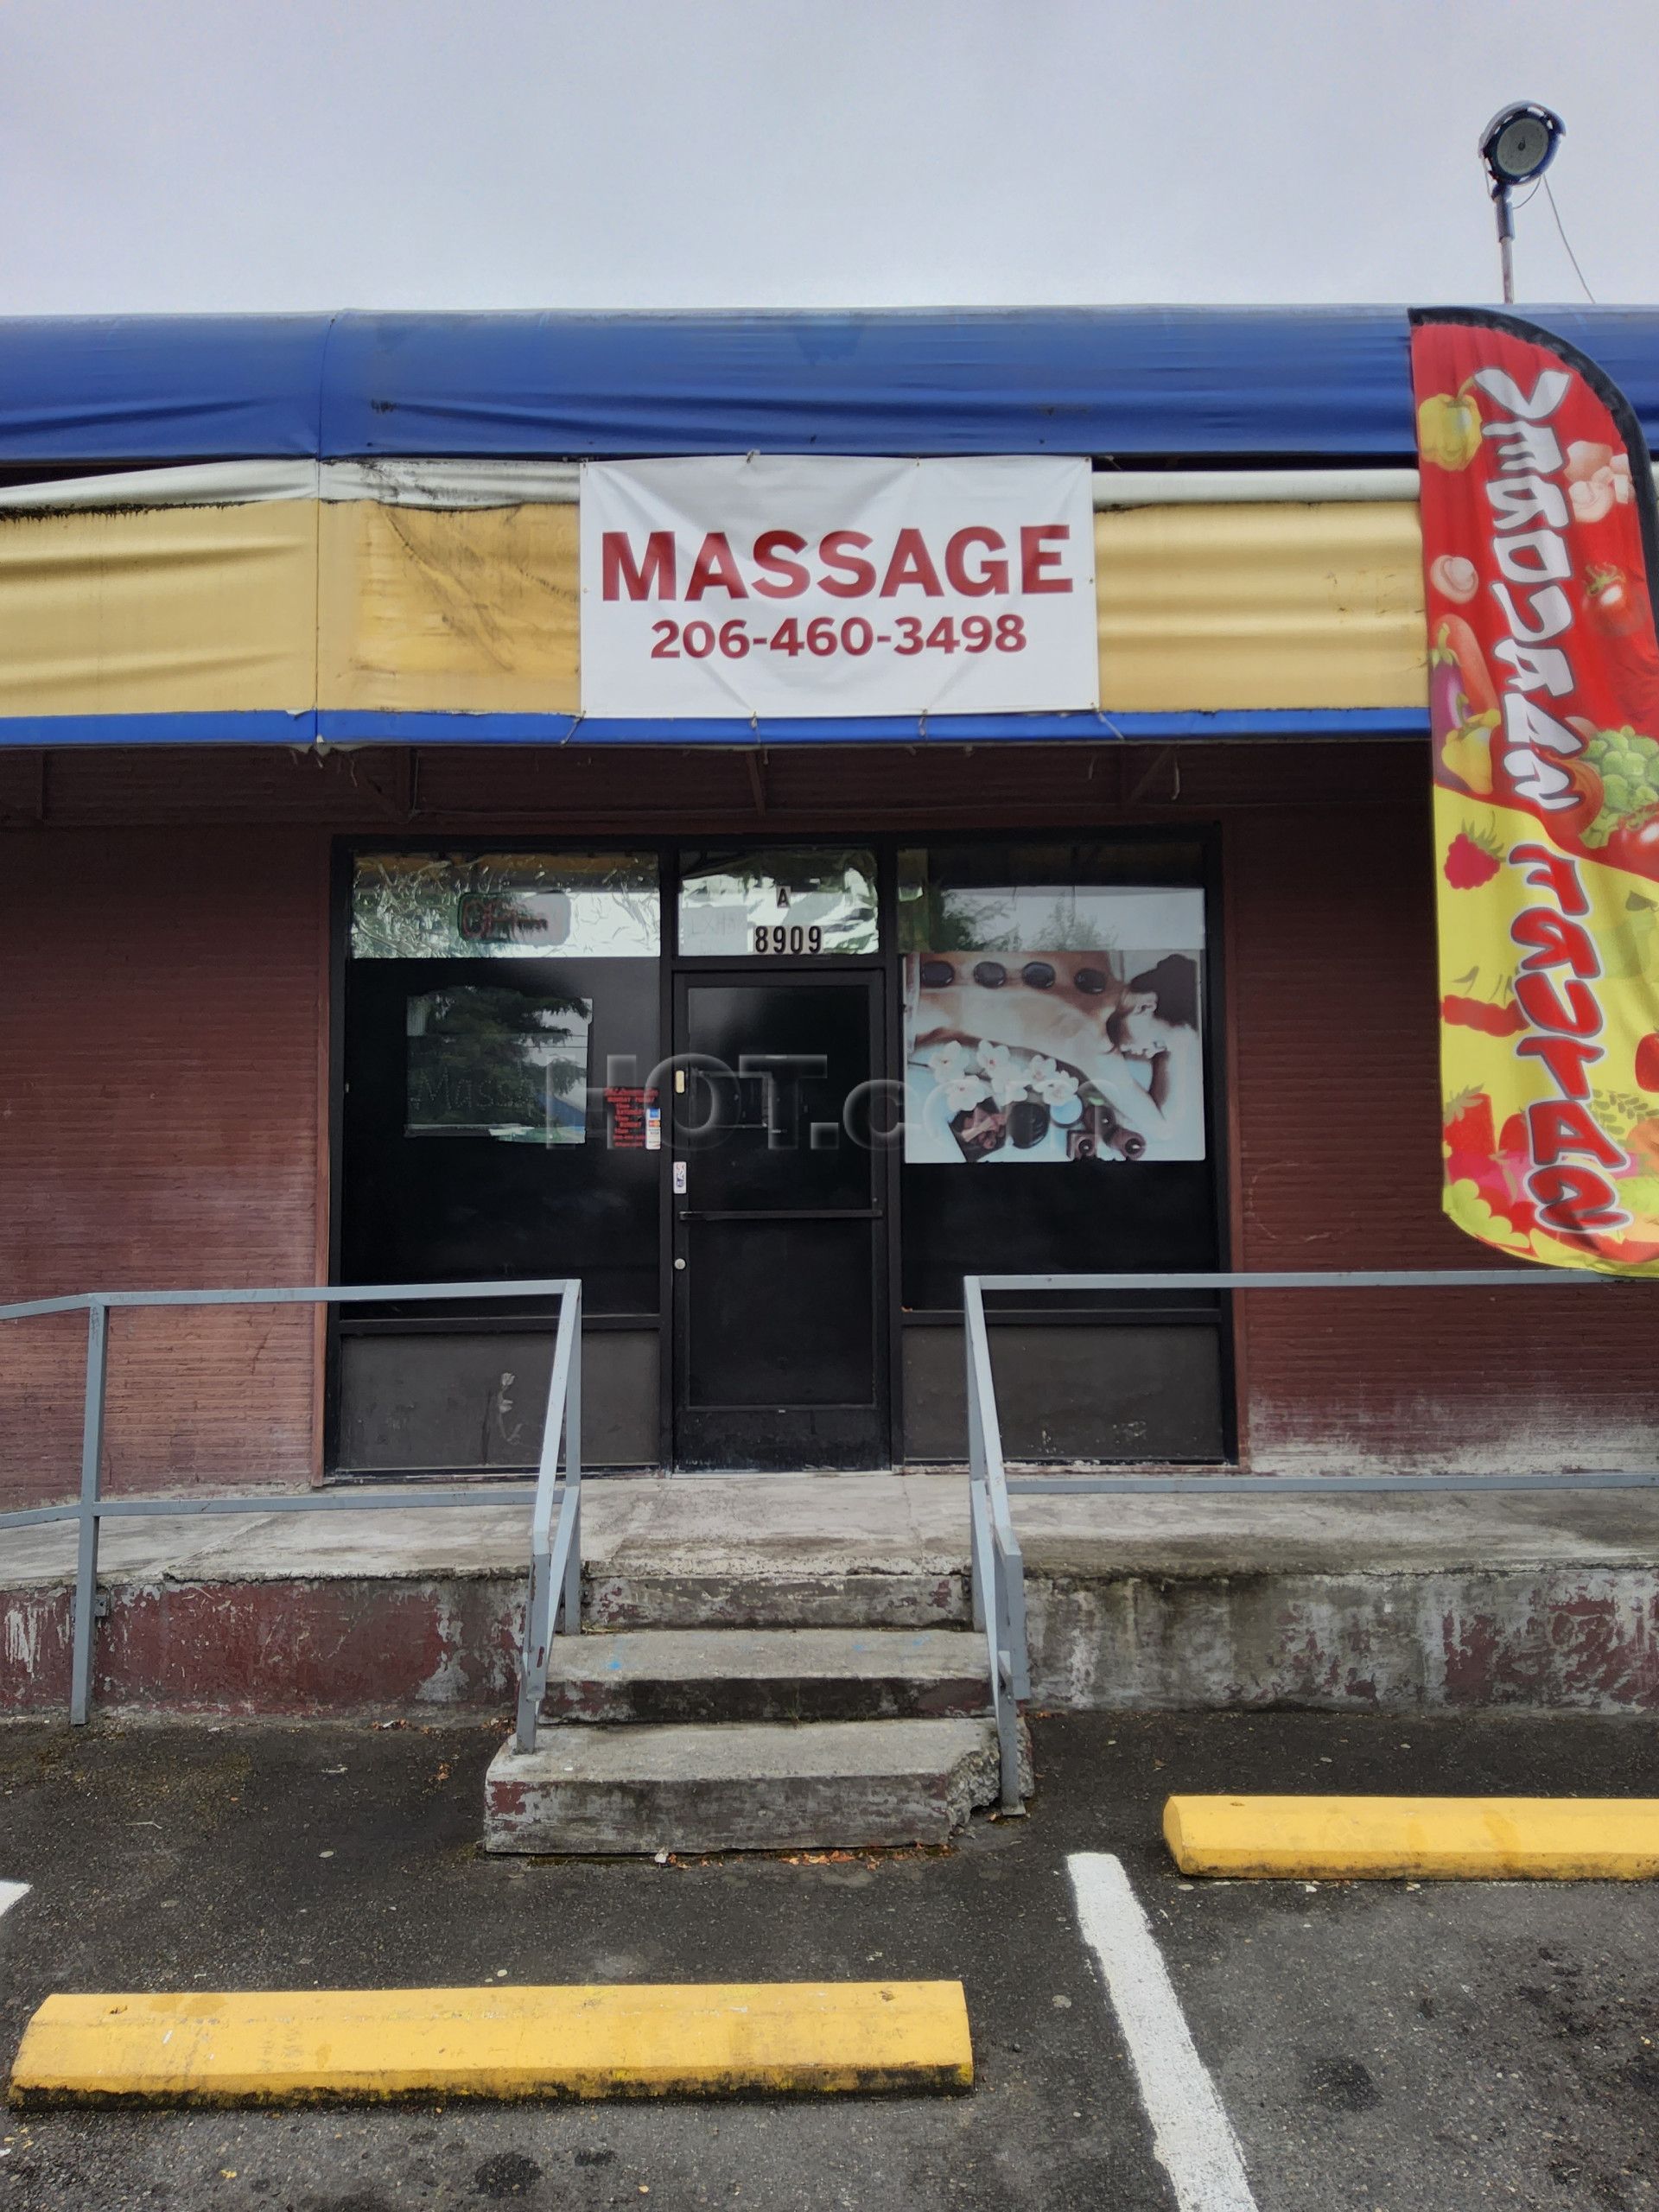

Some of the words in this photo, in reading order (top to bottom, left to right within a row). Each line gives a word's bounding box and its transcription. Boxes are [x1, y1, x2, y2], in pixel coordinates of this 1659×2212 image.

[601, 524, 1074, 602] MASSAGE
[651, 613, 1027, 659] 206-460-3498
[778, 887, 791, 907] A
[754, 925, 822, 954] 8909
